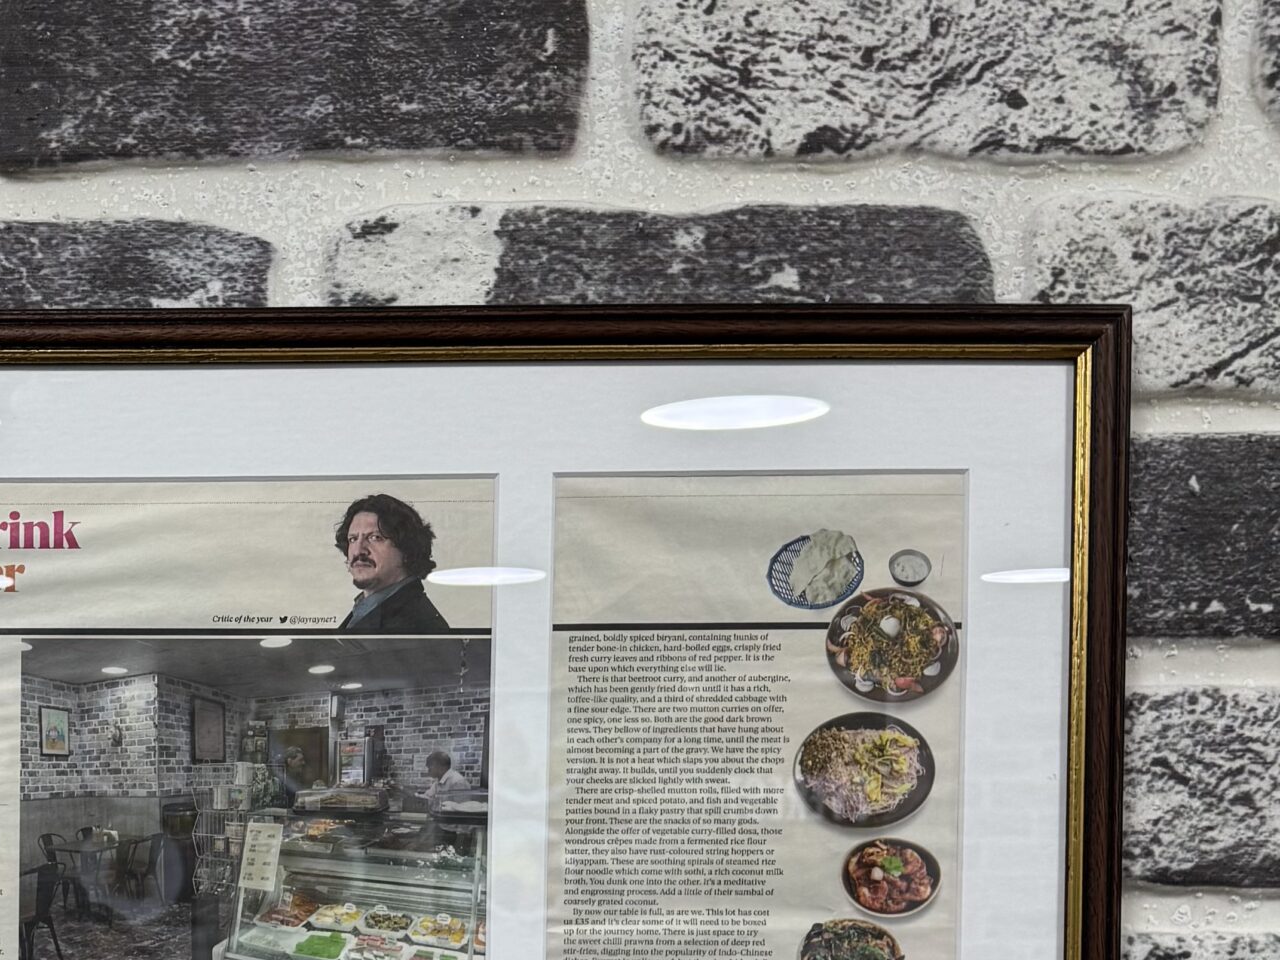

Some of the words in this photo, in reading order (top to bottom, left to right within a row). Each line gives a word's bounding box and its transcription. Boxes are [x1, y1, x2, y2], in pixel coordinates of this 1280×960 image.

[212, 615, 233, 623] Critic
[234, 615, 243, 624] of
[243, 615, 255, 623] the
[256, 616, 273, 624] year
[565, 819, 584, 829] your
[586, 817, 608, 826] front.
[609, 817, 633, 826] These
[649, 817, 662, 826] the
[664, 817, 691, 826] snacks
[692, 817, 701, 826] of
[714, 819, 737, 829] many
[738, 818, 760, 829] gods.
